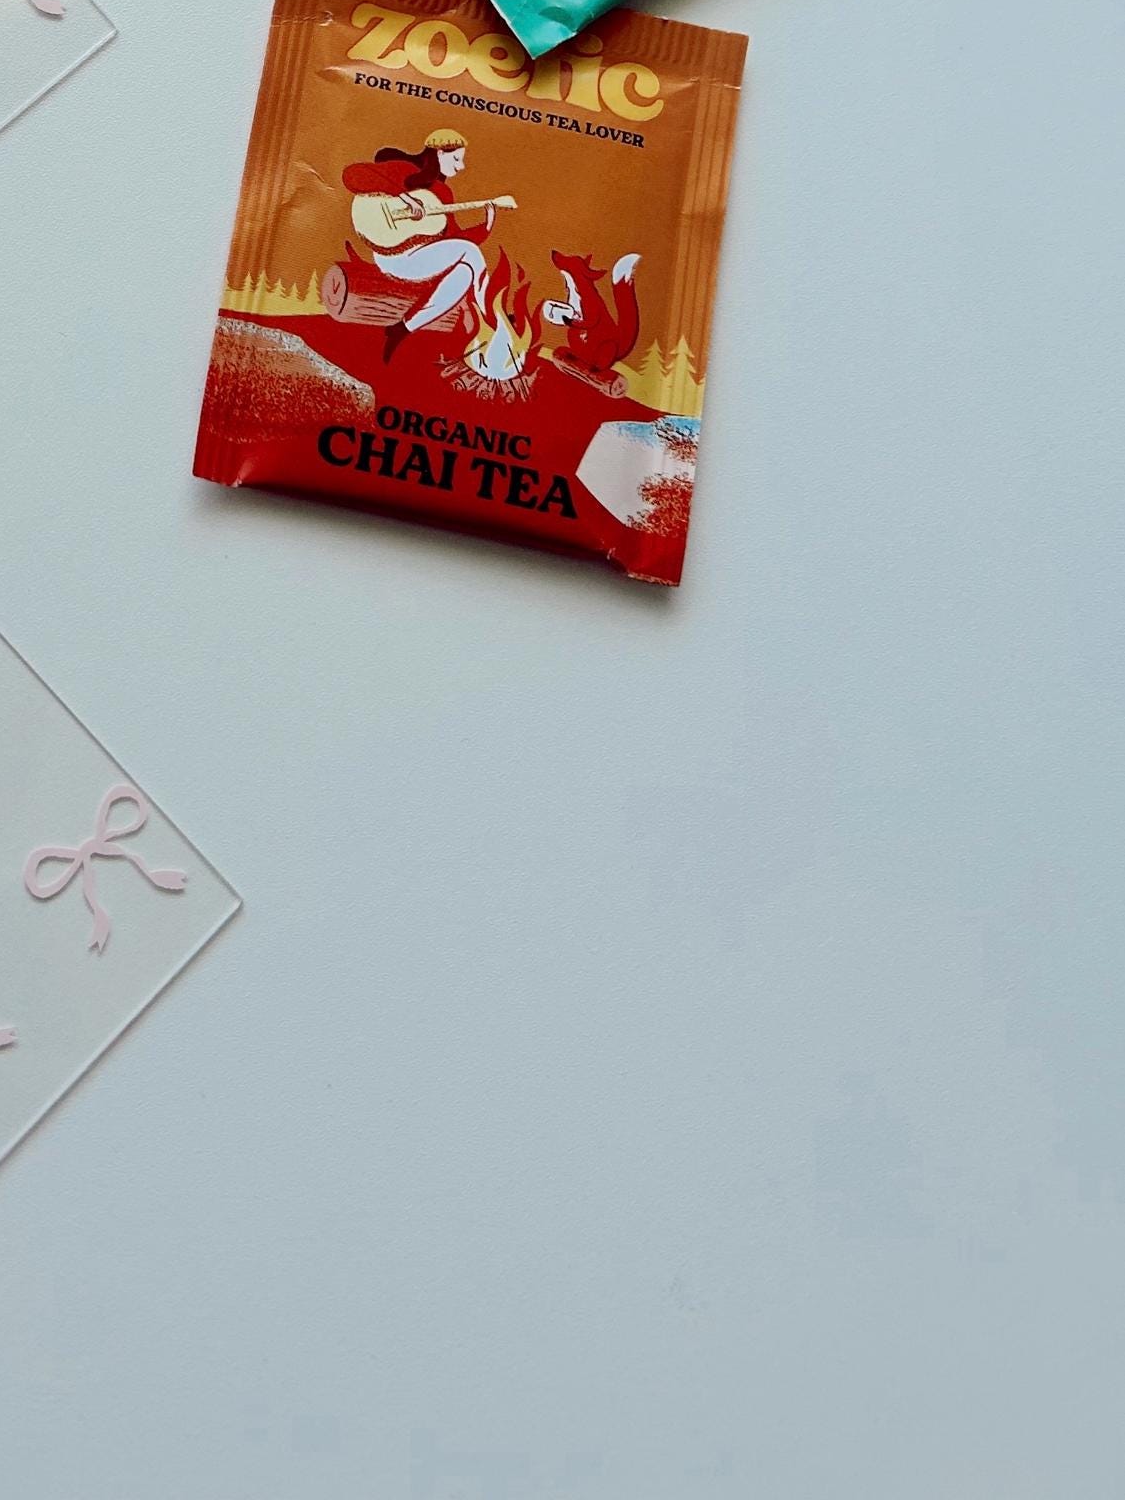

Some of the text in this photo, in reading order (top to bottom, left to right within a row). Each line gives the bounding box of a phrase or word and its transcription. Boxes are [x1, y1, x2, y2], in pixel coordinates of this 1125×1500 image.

[354, 72, 645, 148] FOR THE CONSCIOUS TEA LOVER
[377, 406, 532, 461] ORGANIC
[317, 425, 578, 519] CHAI TEA
